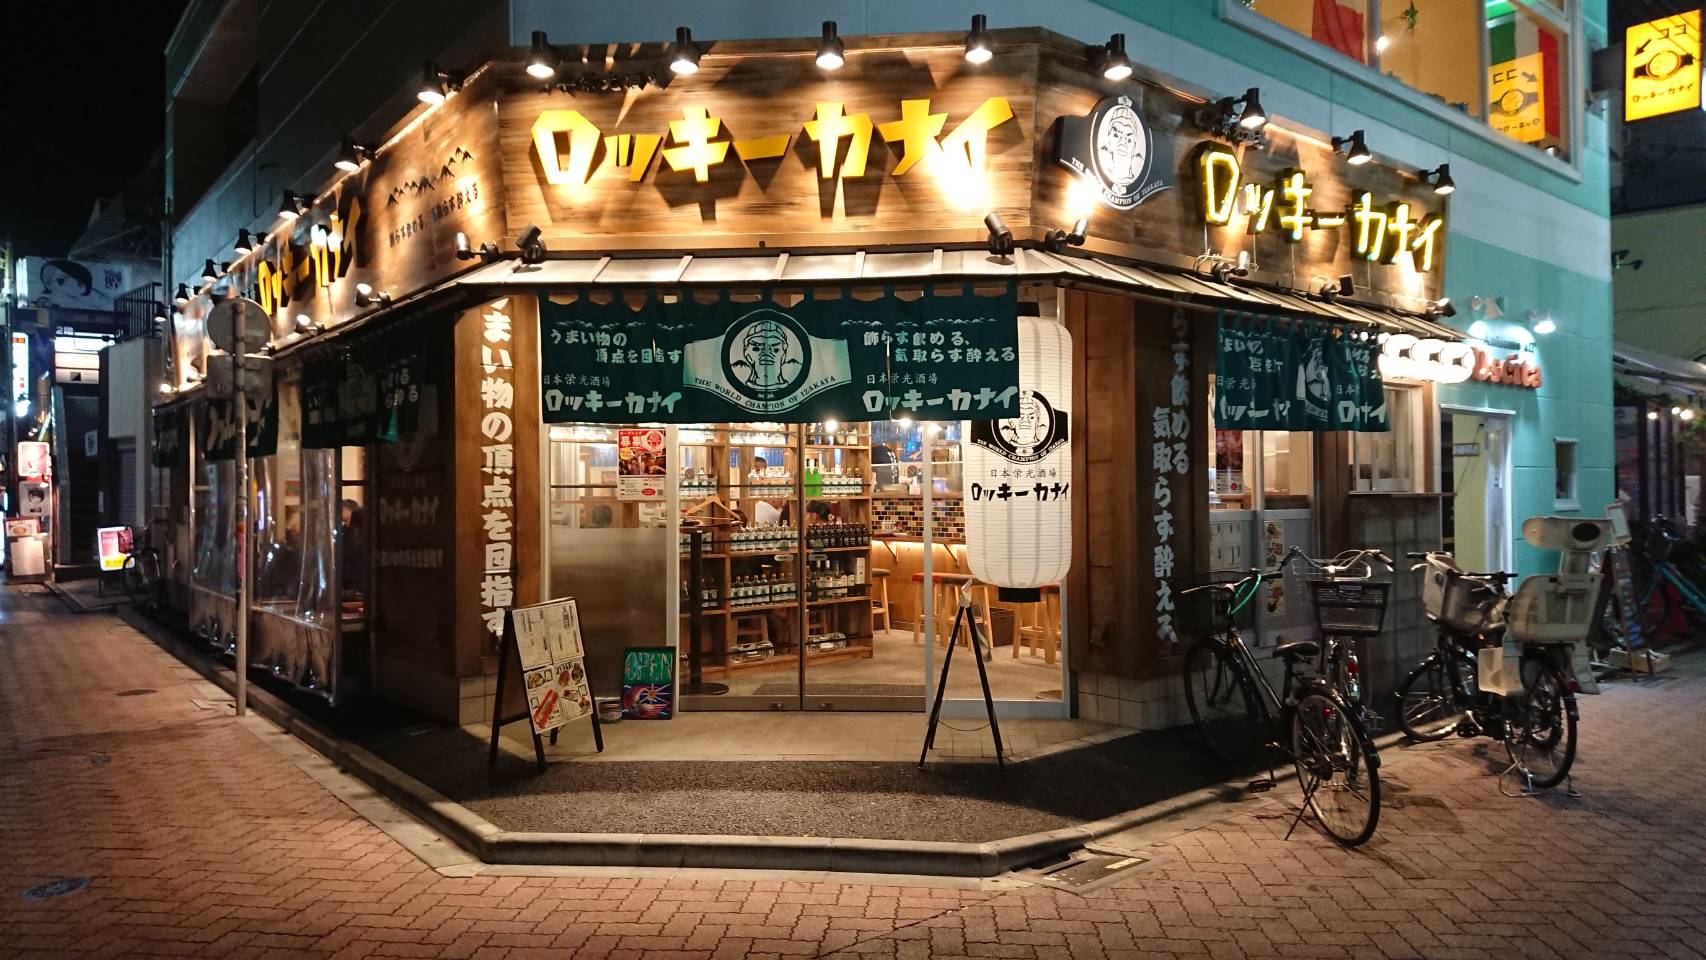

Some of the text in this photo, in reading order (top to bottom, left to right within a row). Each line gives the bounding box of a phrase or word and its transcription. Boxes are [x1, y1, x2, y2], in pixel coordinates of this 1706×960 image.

[530, 97, 1014, 185] ロッキーカナイ
[1201, 146, 1443, 272] ロッキーカナイ
[550, 329, 628, 347] うまい物の
[595, 348, 682, 364] 頂点を目指す
[543, 373, 611, 387] 日本栄光酒場
[866, 374, 939, 385] 日本栄光酒場
[544, 389, 683, 414] ロッキーカナイ
[694, 375, 836, 409] THE WORLD CHAMPION OF IZAKAYA
[862, 386, 1018, 413] ロッキーカナイ
[990, 467, 1057, 479] 日本栄光酒場
[971, 482, 1069, 501] ロッキーカナイ
[625, 652, 674, 681] OPEN
